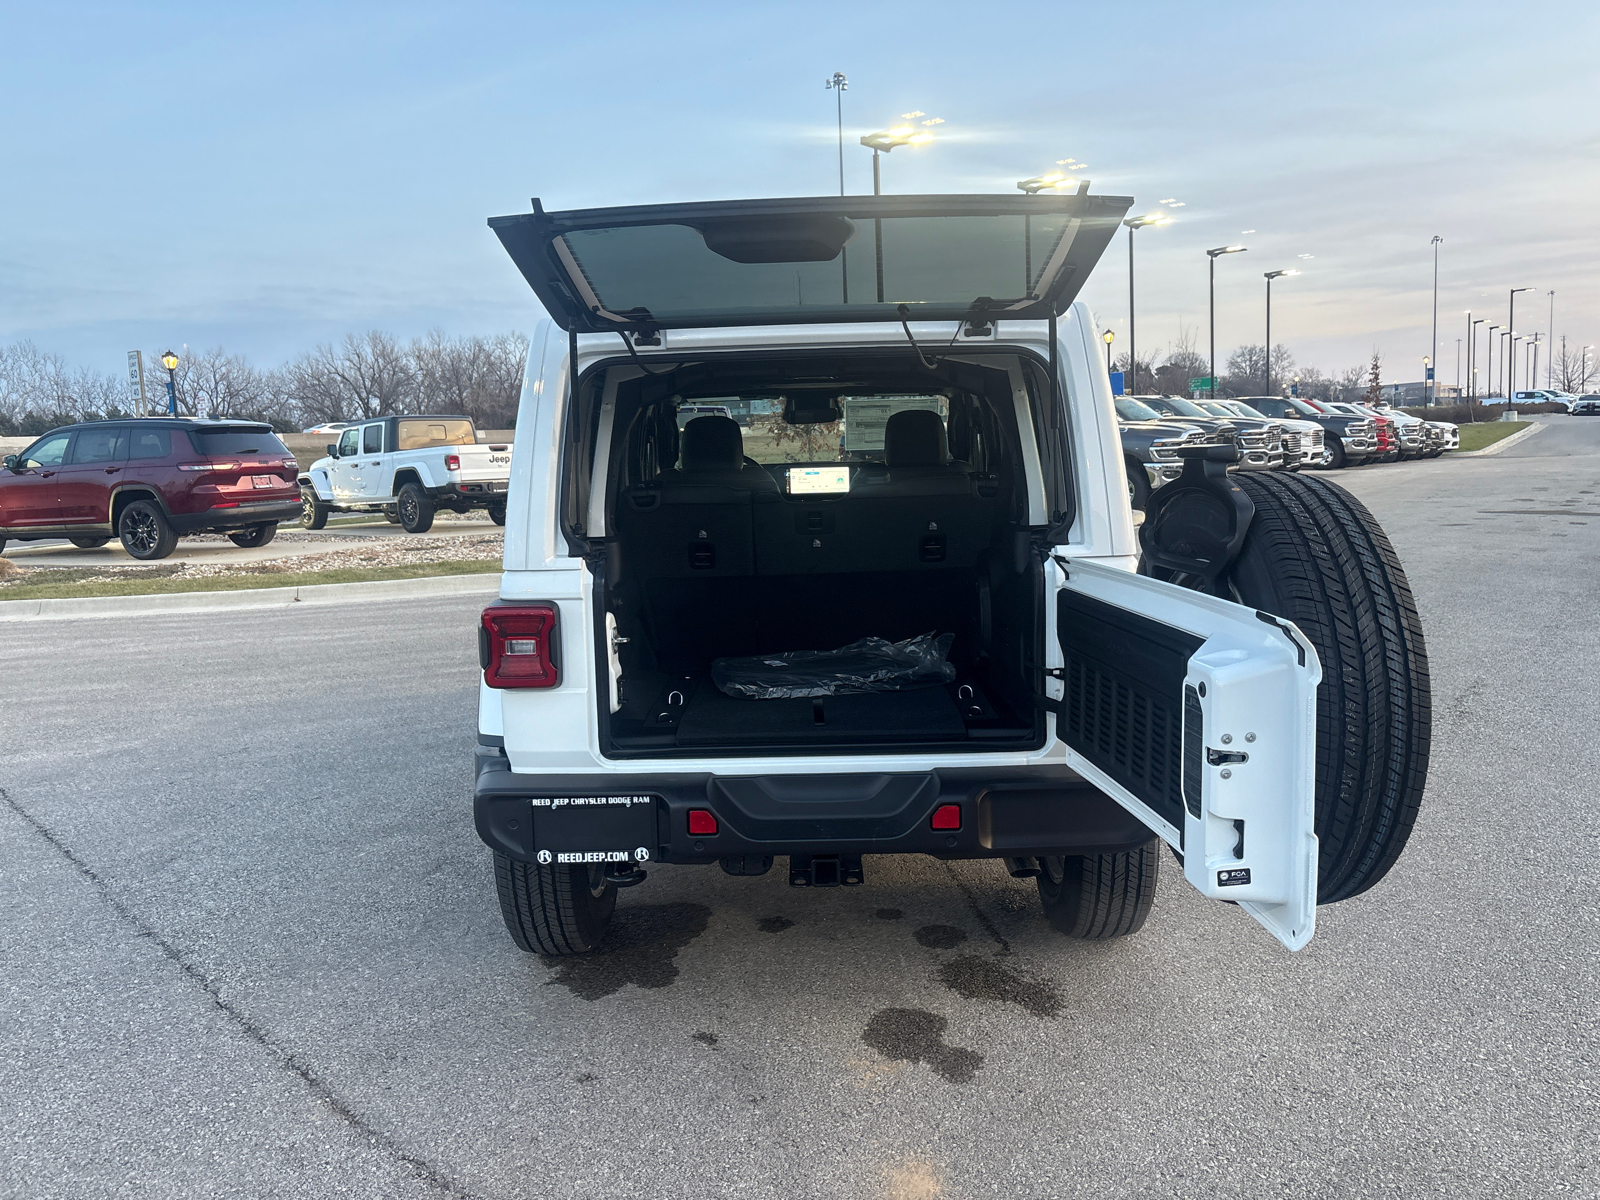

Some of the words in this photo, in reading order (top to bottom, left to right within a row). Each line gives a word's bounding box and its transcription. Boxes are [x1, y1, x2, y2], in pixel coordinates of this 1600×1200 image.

[489, 455, 510, 464] Jeep
[532, 798, 550, 806] REED
[552, 798, 569, 806] JEEP
[571, 797, 606, 805] CHRYSLER
[608, 796, 631, 804] DODGE
[558, 851, 628, 863] REEDJEEP.COM
